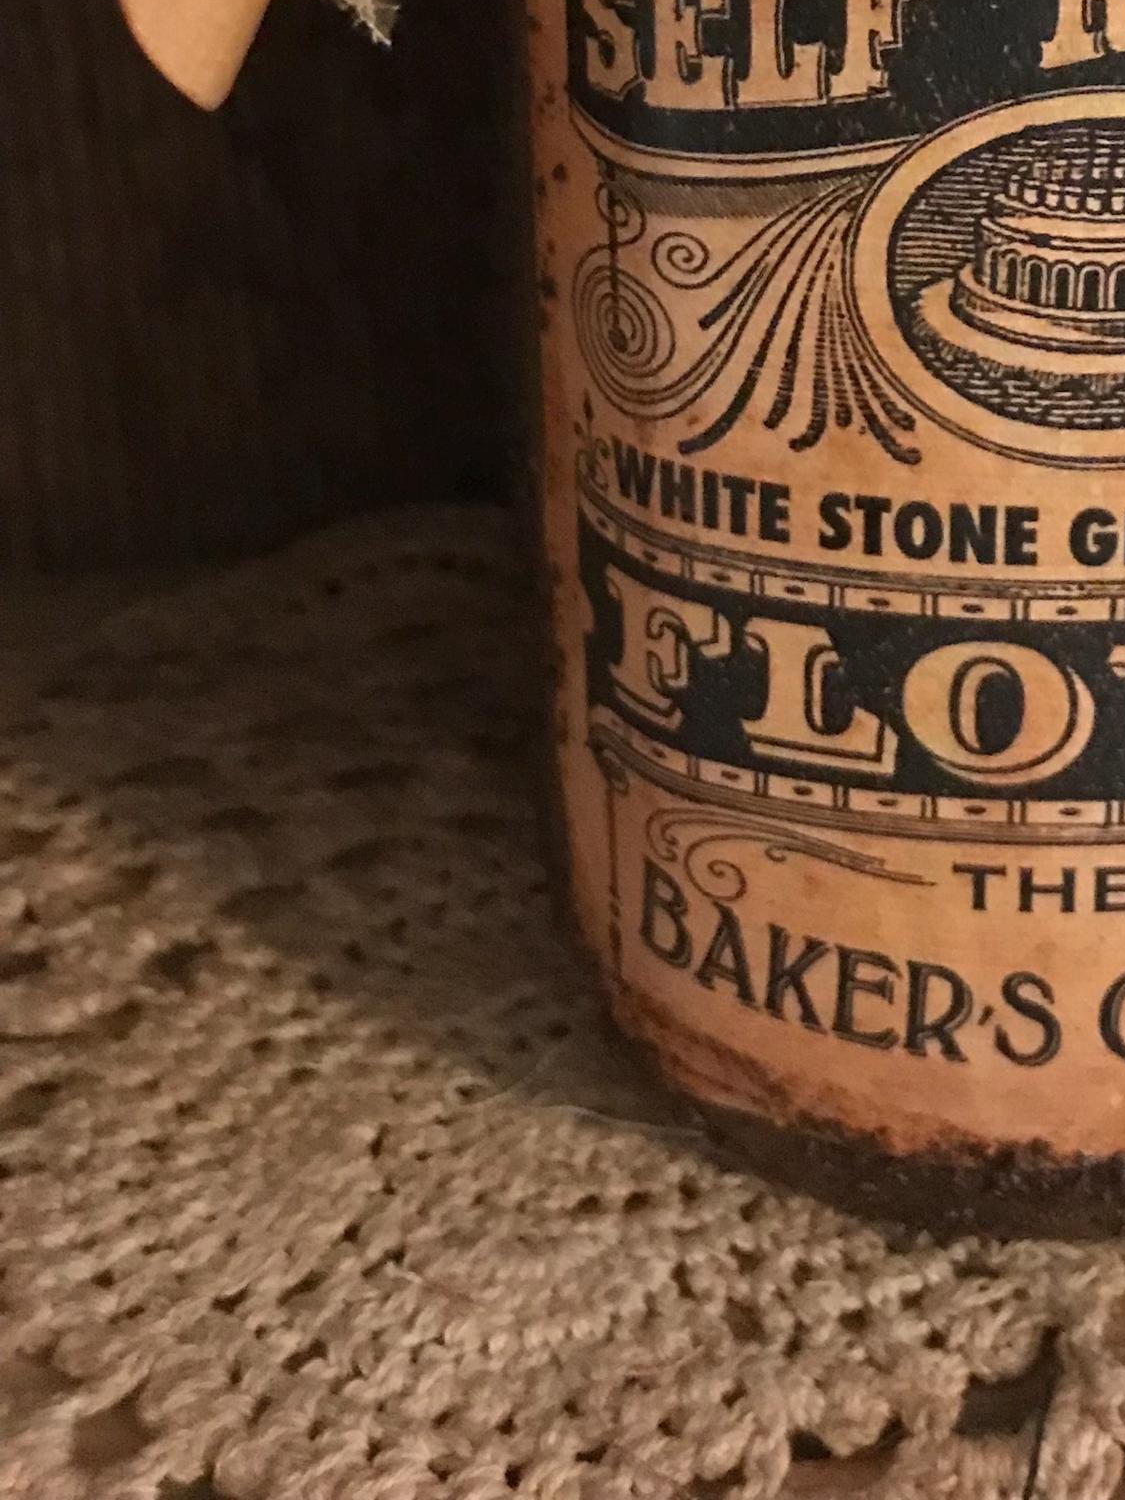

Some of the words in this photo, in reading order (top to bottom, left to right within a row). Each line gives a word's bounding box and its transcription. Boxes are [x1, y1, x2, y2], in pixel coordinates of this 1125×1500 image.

[612, 438, 791, 544] WHITE
[818, 492, 1039, 567] STONE
[640, 855, 1062, 1067] BAKER'S
